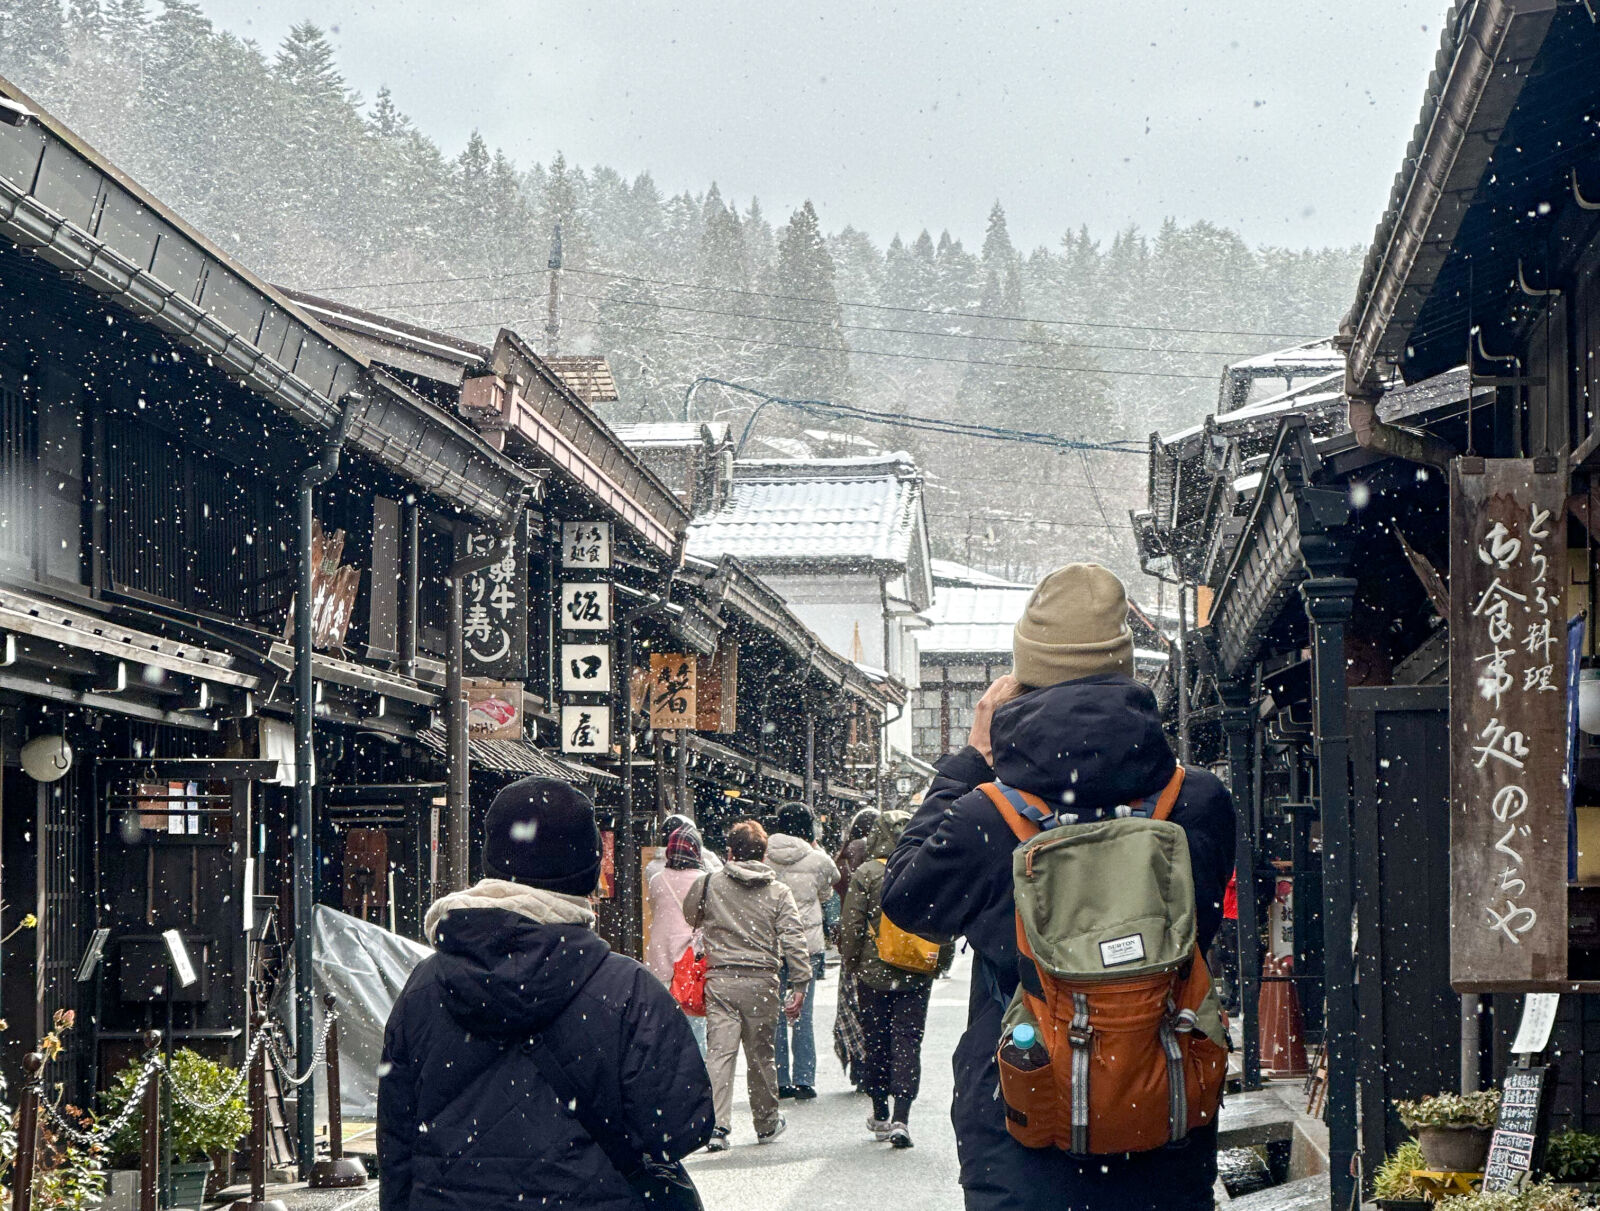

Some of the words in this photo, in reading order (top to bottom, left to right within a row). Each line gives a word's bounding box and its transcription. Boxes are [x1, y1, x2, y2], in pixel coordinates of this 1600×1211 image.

[463, 532, 512, 663] にり寿し
[488, 534, 517, 620] 騨牛
[1521, 502, 1560, 692] とうふ料理
